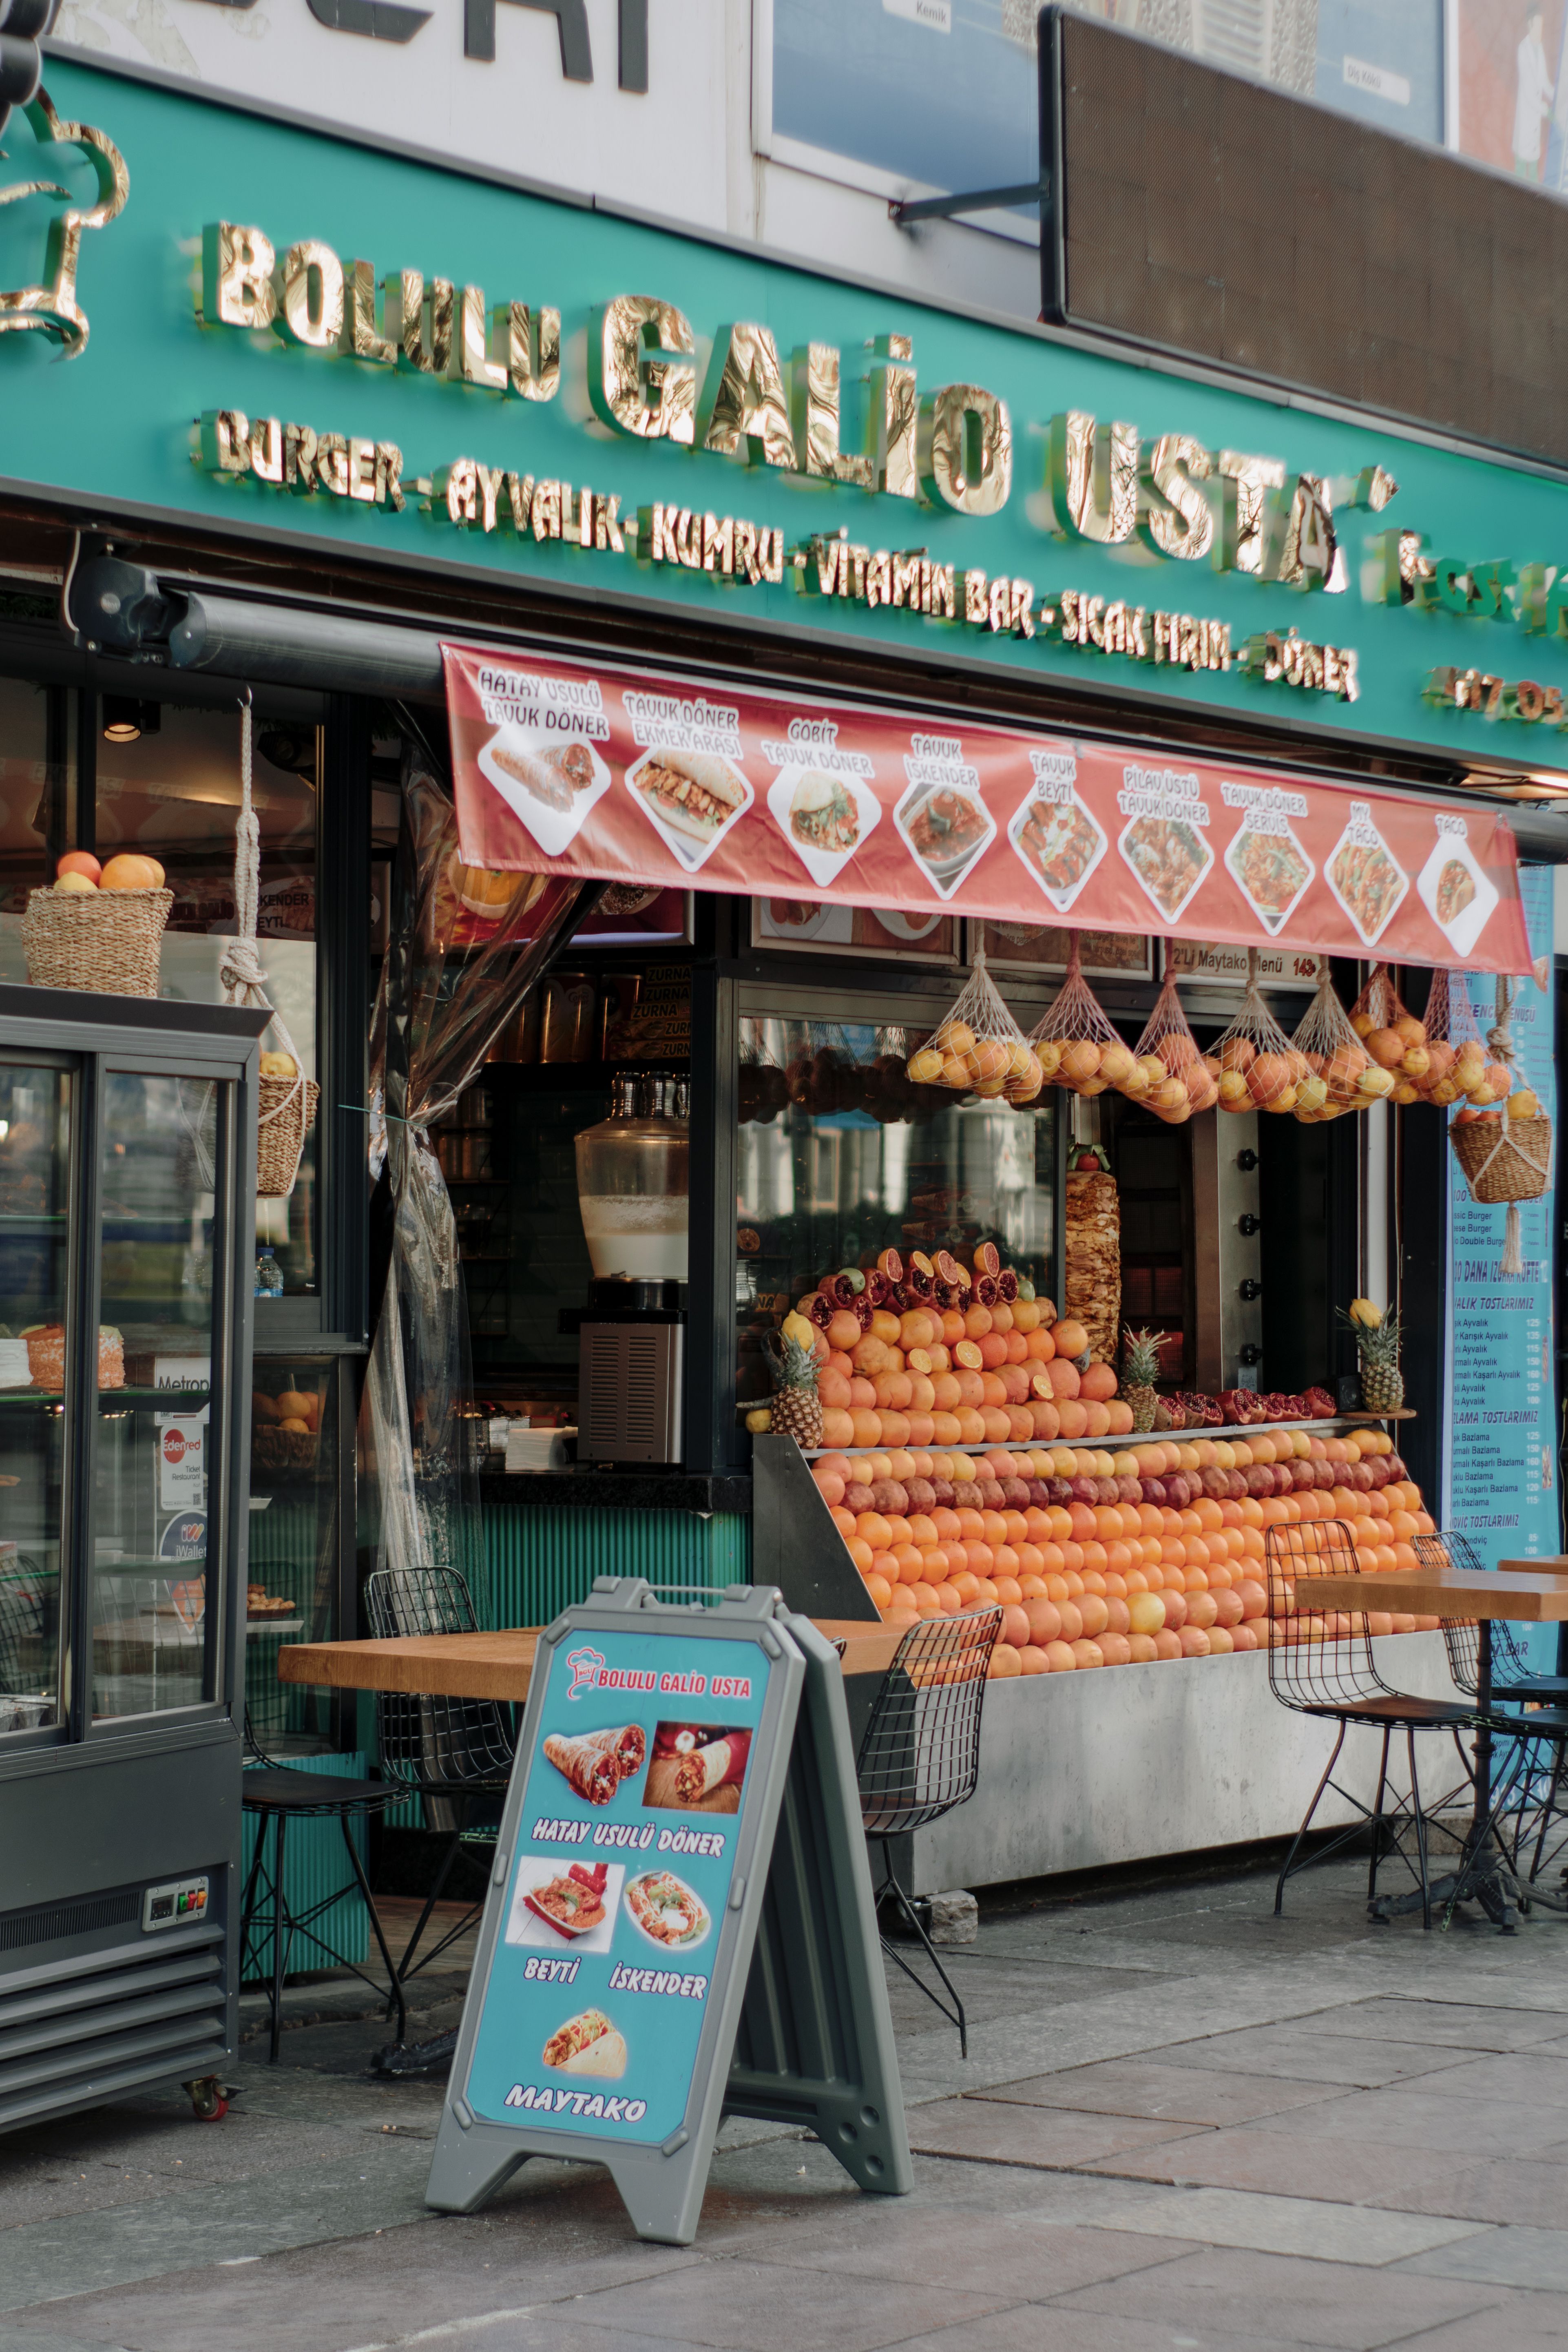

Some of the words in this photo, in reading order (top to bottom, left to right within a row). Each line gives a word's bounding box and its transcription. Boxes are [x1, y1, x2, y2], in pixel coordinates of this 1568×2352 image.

[916, 0, 947, 24] Kemik
[206, 219, 562, 403] BOLULU
[591, 294, 1011, 516] GALİO
[208, 409, 406, 514] BURGER
[442, 457, 626, 554] AYVALIK
[648, 503, 784, 586] KUMRU
[964, 568, 1036, 640] BAR
[1257, 626, 1360, 703] DÖNER
[481, 671, 541, 699] HATAY
[546, 684, 600, 708] USULÜ
[484, 699, 539, 727] TAVUK
[546, 706, 607, 736] DÖNER
[626, 695, 680, 721] TAVUK
[683, 700, 738, 729] DÖNER
[635, 724, 689, 746] EKMEK
[692, 732, 741, 755] ARASI
[790, 721, 836, 746] GOBİT
[913, 735, 961, 761] TAVUK
[763, 743, 817, 766] TAVUK
[819, 749, 872, 776] DÖNER
[1032, 754, 1076, 777] TAVUK
[905, 757, 979, 787] İSKENDER
[1037, 777, 1075, 803] BEYTİ
[1126, 766, 1162, 791] PİLAV
[1165, 771, 1199, 799] ÜSTÜ
[1119, 793, 1162, 816] TAVUK
[1165, 798, 1209, 824] DÖNER
[1223, 785, 1261, 808] TAVUK
[1264, 789, 1306, 815] DÖNER
[1246, 812, 1289, 834] SERVİS
[1437, 816, 1467, 837] TACO
[1347, 826, 1380, 846] TACO
[258, 893, 310, 907] KENDER
[1198, 949, 1247, 972] Maytako
[649, 965, 692, 981] ZURNA
[646, 987, 690, 1002] ZURNA
[633, 1004, 678, 1018] ZURNA
[1510, 1005, 1536, 1024] ENÜSÜ
[1468, 1211, 1492, 1221] Burger
[1468, 1224, 1492, 1234] Burger
[1460, 1237, 1485, 1246] Double
[1487, 1237, 1506, 1247] Burge
[1464, 1259, 1488, 1283] DANA
[1480, 1297, 1534, 1310] TOSTLARIMIZ
[1463, 1319, 1488, 1329] Ayvalık
[1460, 1332, 1484, 1342] Karışık
[1485, 1332, 1508, 1342] Ayvalık
[1462, 1344, 1487, 1355] Ayvalık
[1473, 1358, 1497, 1368] Ayvalık
[1473, 1370, 1496, 1381] Kaşarlı
[1497, 1370, 1521, 1381] Ayvalık
[1461, 1383, 1486, 1394] Ayvalık
[1461, 1396, 1486, 1407] Ayvalık
[1482, 1410, 1538, 1423] TOSTLARIMIZ
[163, 1439, 201, 1451] Edenred
[1462, 1433, 1490, 1441] Bazlama
[1472, 1446, 1501, 1454] Bazlama
[1471, 1459, 1495, 1469] Kaşarlı
[1497, 1458, 1524, 1467] Bazlama
[1465, 1472, 1493, 1480] Bazlama
[1465, 1485, 1488, 1495] Kaşarlı
[1490, 1484, 1518, 1493] Bazlama
[1461, 1498, 1489, 1507] Bazlama
[1470, 1513, 1519, 1529] TOSTLARIMIZ
[176, 1545, 207, 1557] iWallet
[598, 1669, 656, 1690] BOLULU
[660, 1670, 705, 1694] GALİO
[711, 1676, 750, 1697] USTA
[532, 1817, 592, 1844] HATAY
[592, 1822, 656, 1850] USULÜ
[657, 1825, 726, 1858] DÖNER
[523, 1956, 582, 1984] BEYTİ
[608, 1960, 709, 2000] İSKENDER
[504, 2083, 648, 2123] MAYTAKO
